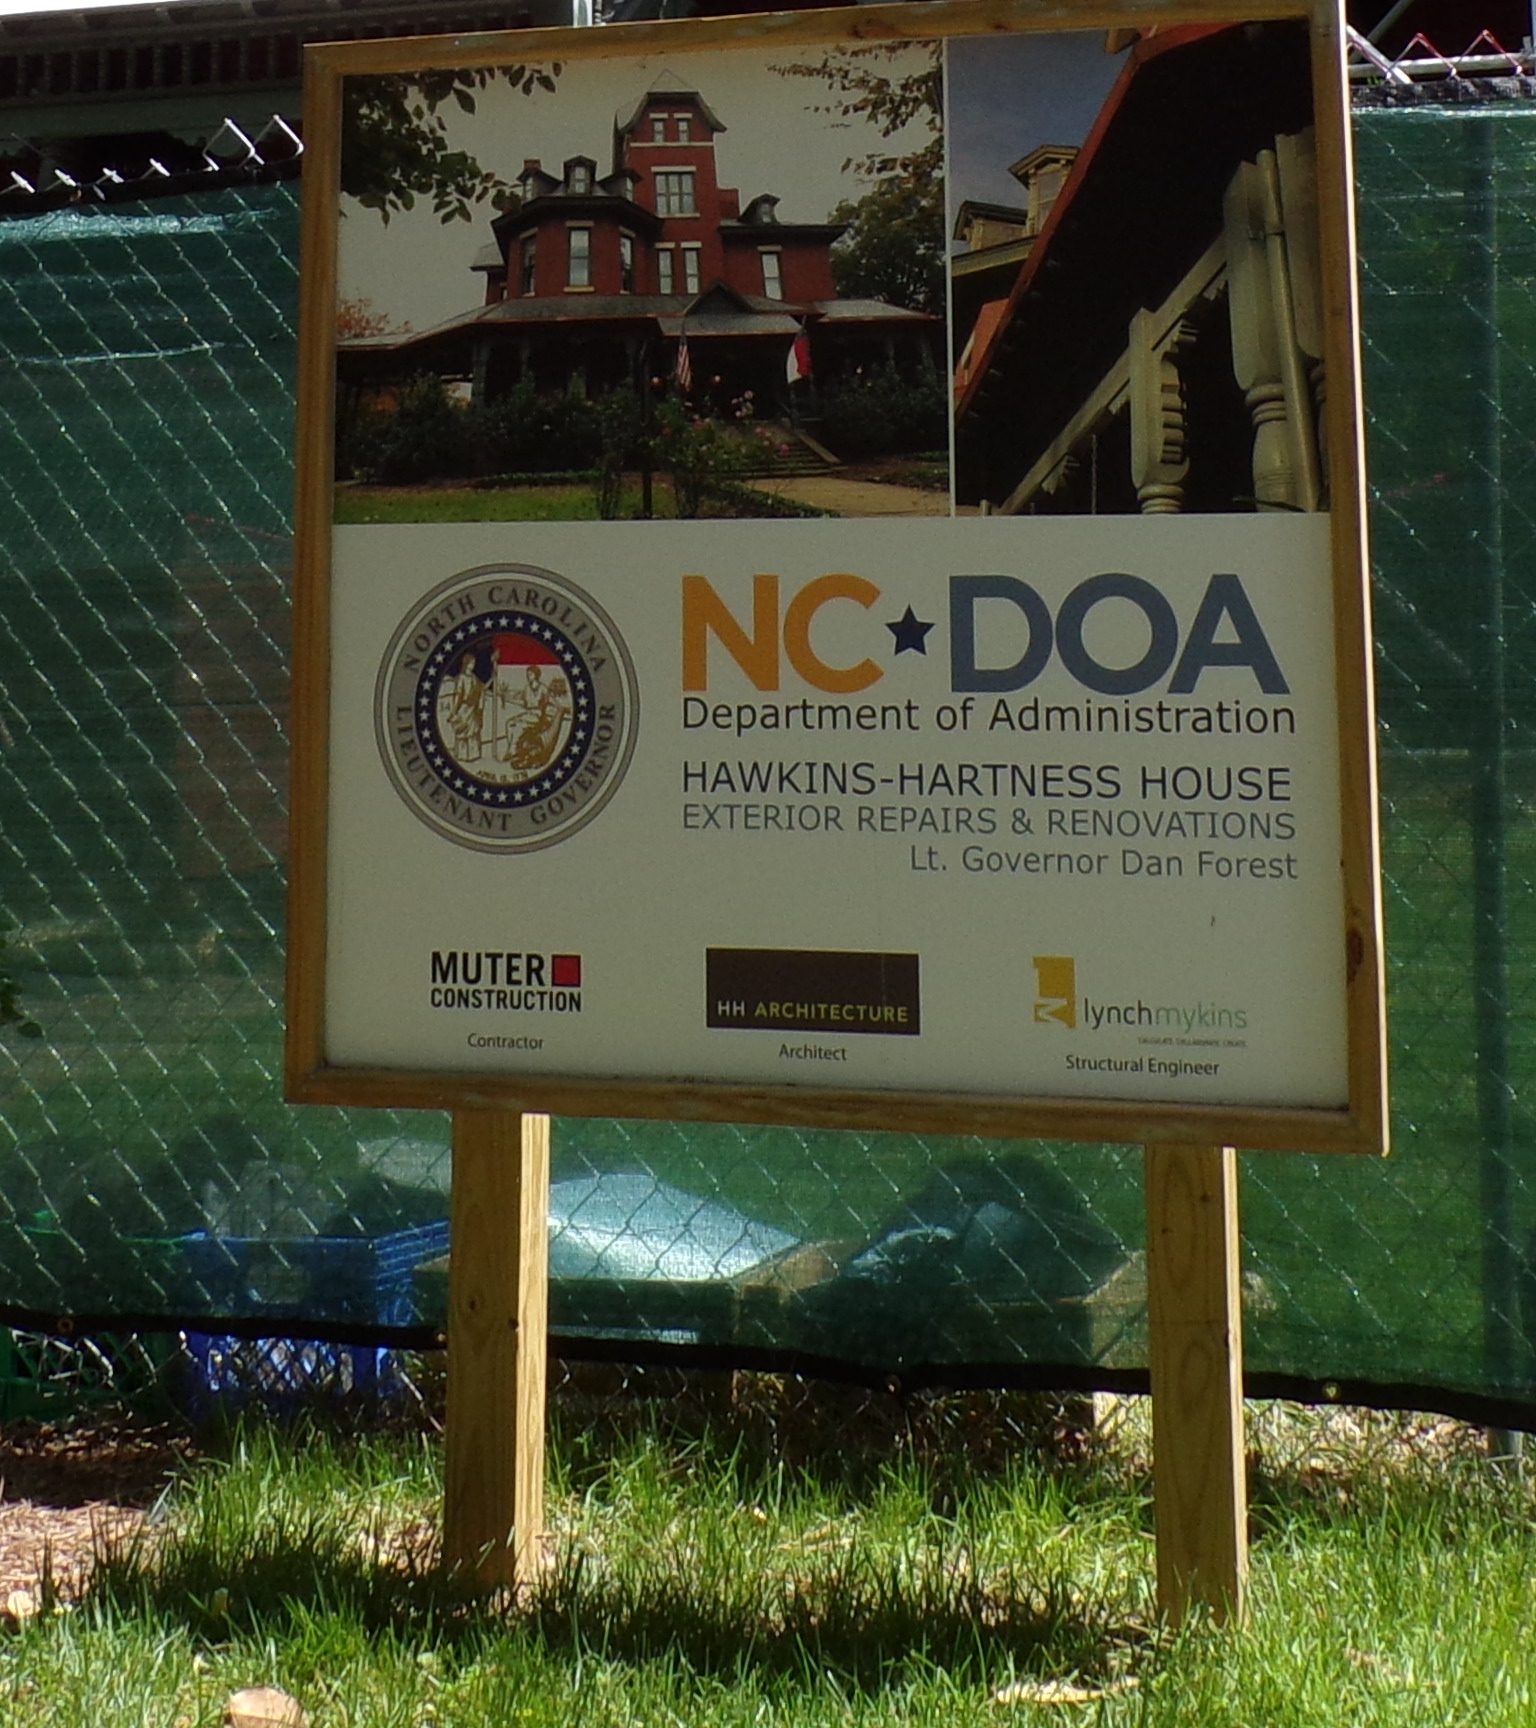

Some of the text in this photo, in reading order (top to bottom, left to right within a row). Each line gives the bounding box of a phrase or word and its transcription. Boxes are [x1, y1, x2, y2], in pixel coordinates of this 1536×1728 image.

[404, 586, 606, 672] NORTH CAROLINA
[682, 573, 1291, 695] NC DOA
[682, 697, 1295, 737] Department of Administration
[396, 704, 614, 831] LIEUTENANT GOVERNOR
[682, 760, 1291, 801] HAWKINS-HARTNESS HOUSE
[682, 803, 1296, 840] EXTERIOR REPAIRS & RENOVATIONS
[910, 845, 1298, 879] Lt. Governor Dan Forest
[431, 951, 545, 987] MUTER
[430, 987, 582, 1013] CONSTRUCTION
[717, 1000, 909, 1022] HH ARCHITECTURE
[1083, 997, 1248, 1034] lynchmykins
[467, 1032, 544, 1050] Contractor
[779, 1043, 847, 1061] Architect
[1066, 1054, 1220, 1078] Structural Engineer
